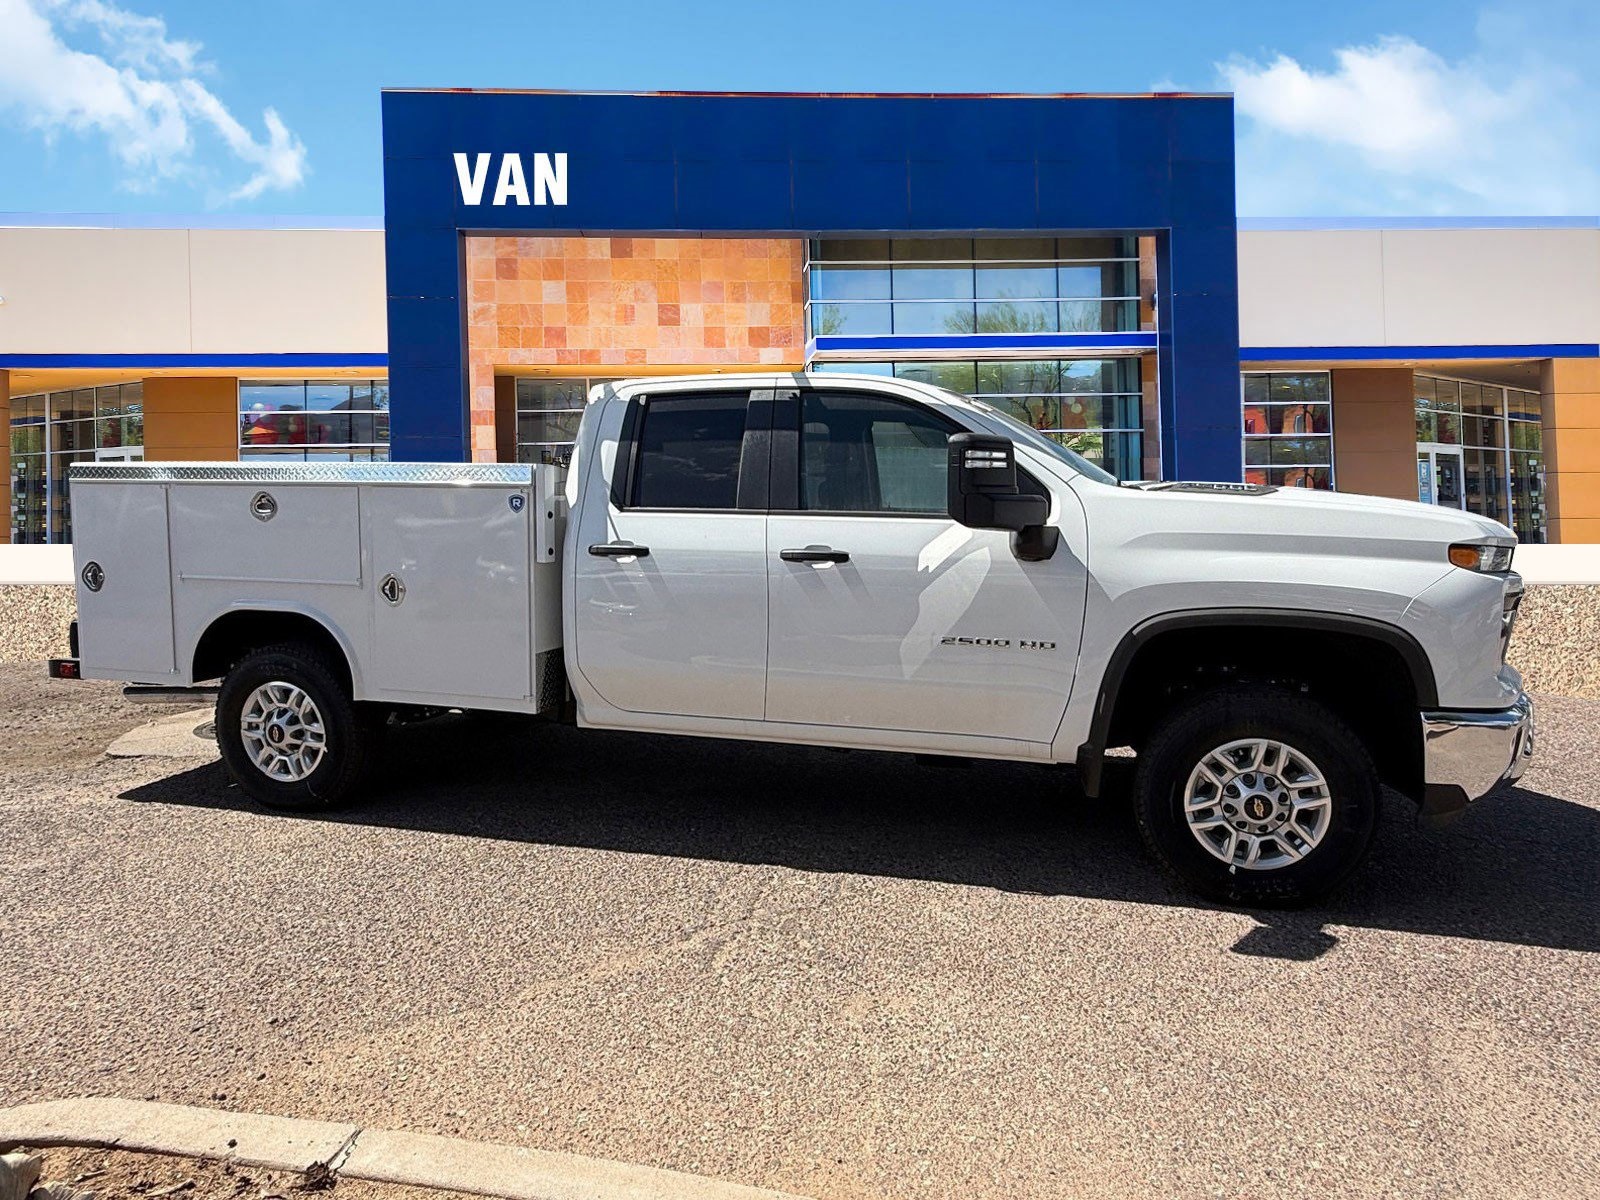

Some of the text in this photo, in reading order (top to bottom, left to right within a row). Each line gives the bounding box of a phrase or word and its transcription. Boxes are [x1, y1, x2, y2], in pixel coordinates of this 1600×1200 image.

[453, 152, 568, 206] VAN
[940, 636, 1056, 650] 2500 HD
